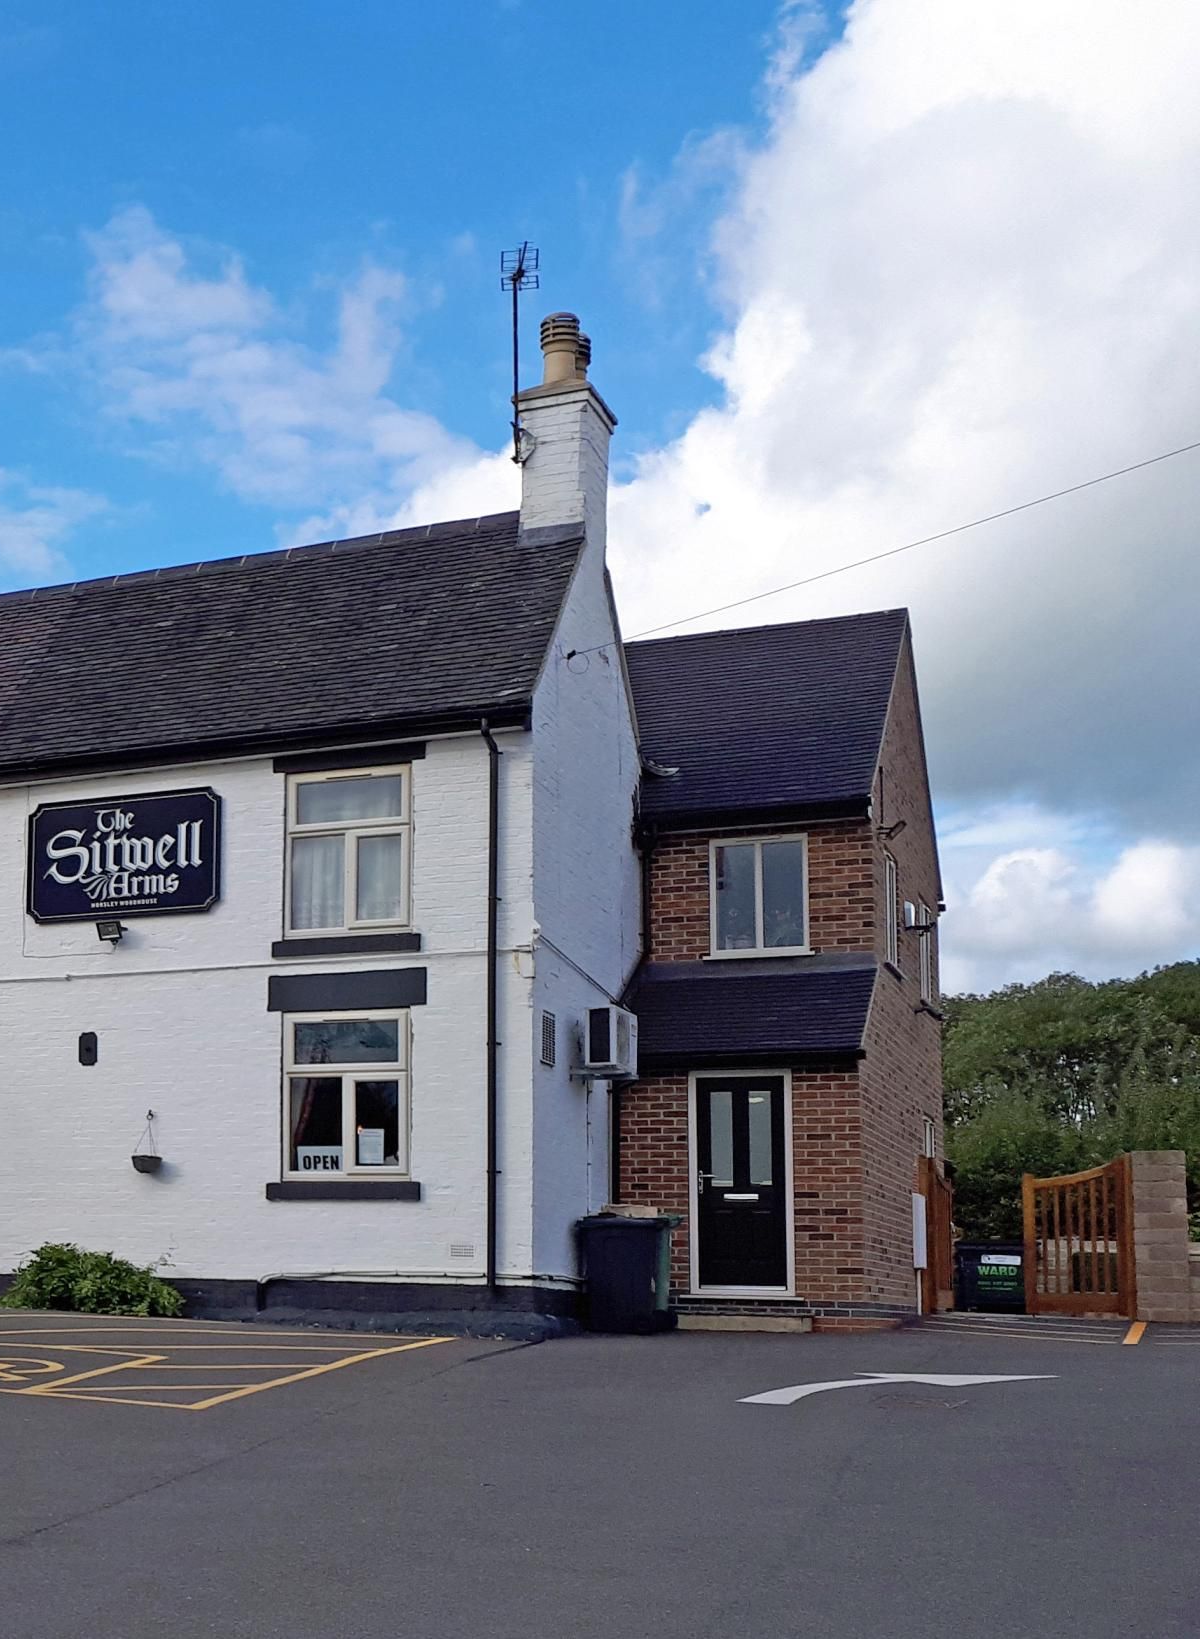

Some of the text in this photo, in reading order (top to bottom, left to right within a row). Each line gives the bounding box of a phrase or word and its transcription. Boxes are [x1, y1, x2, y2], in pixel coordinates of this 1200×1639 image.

[94, 808, 135, 832] The
[43, 819, 203, 885] Sitwell
[107, 871, 180, 900] Arms
[303, 1155, 340, 1170] OPEN
[977, 1266, 1018, 1276] WARD
